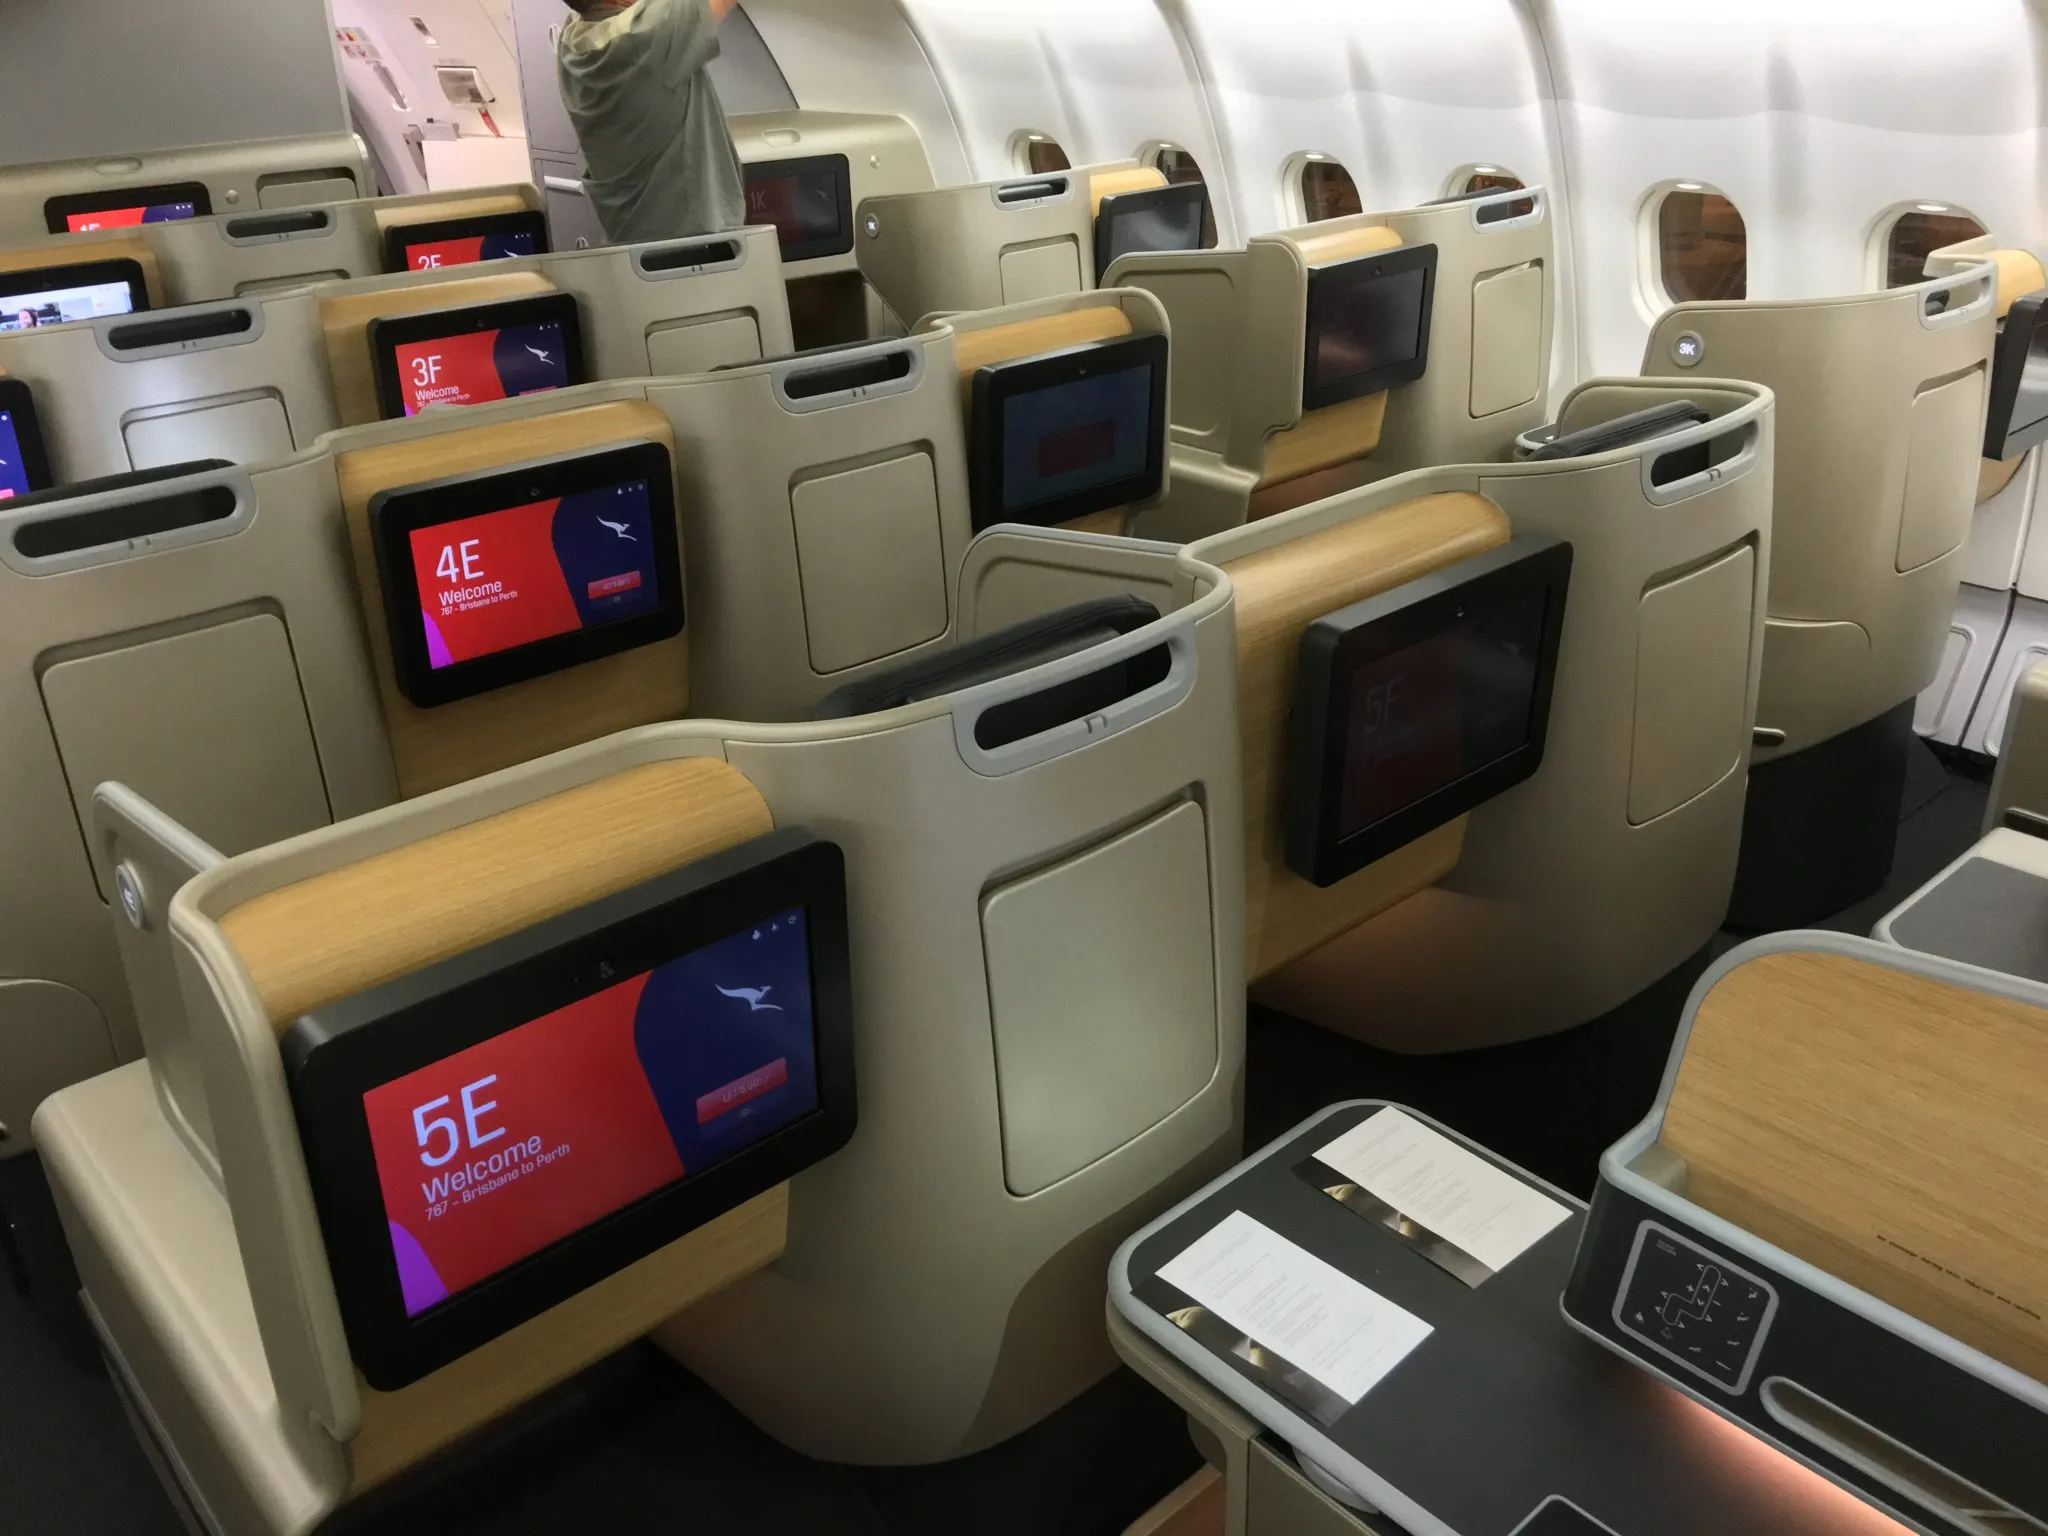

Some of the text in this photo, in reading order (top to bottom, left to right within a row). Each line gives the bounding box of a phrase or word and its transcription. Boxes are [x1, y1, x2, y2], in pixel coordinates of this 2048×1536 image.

[750, 190, 768, 211] 1K
[1679, 342, 1696, 356] 3K
[411, 354, 442, 387] 3F
[415, 385, 460, 401] Welcome
[436, 539, 485, 583] 4E
[438, 580, 503, 607] Welcome
[440, 606, 454, 617] 767
[459, 598, 491, 612] Brisbane
[490, 595, 498, 604] to
[498, 590, 518, 601] Perth
[1364, 674, 1405, 735] 5F
[412, 1073, 507, 1167] 5E
[421, 1135, 543, 1204] Welcome
[425, 1200, 449, 1221] 767
[461, 1167, 520, 1204] Brisbane
[520, 1161, 534, 1175] to
[535, 1143, 571, 1168] Perth
